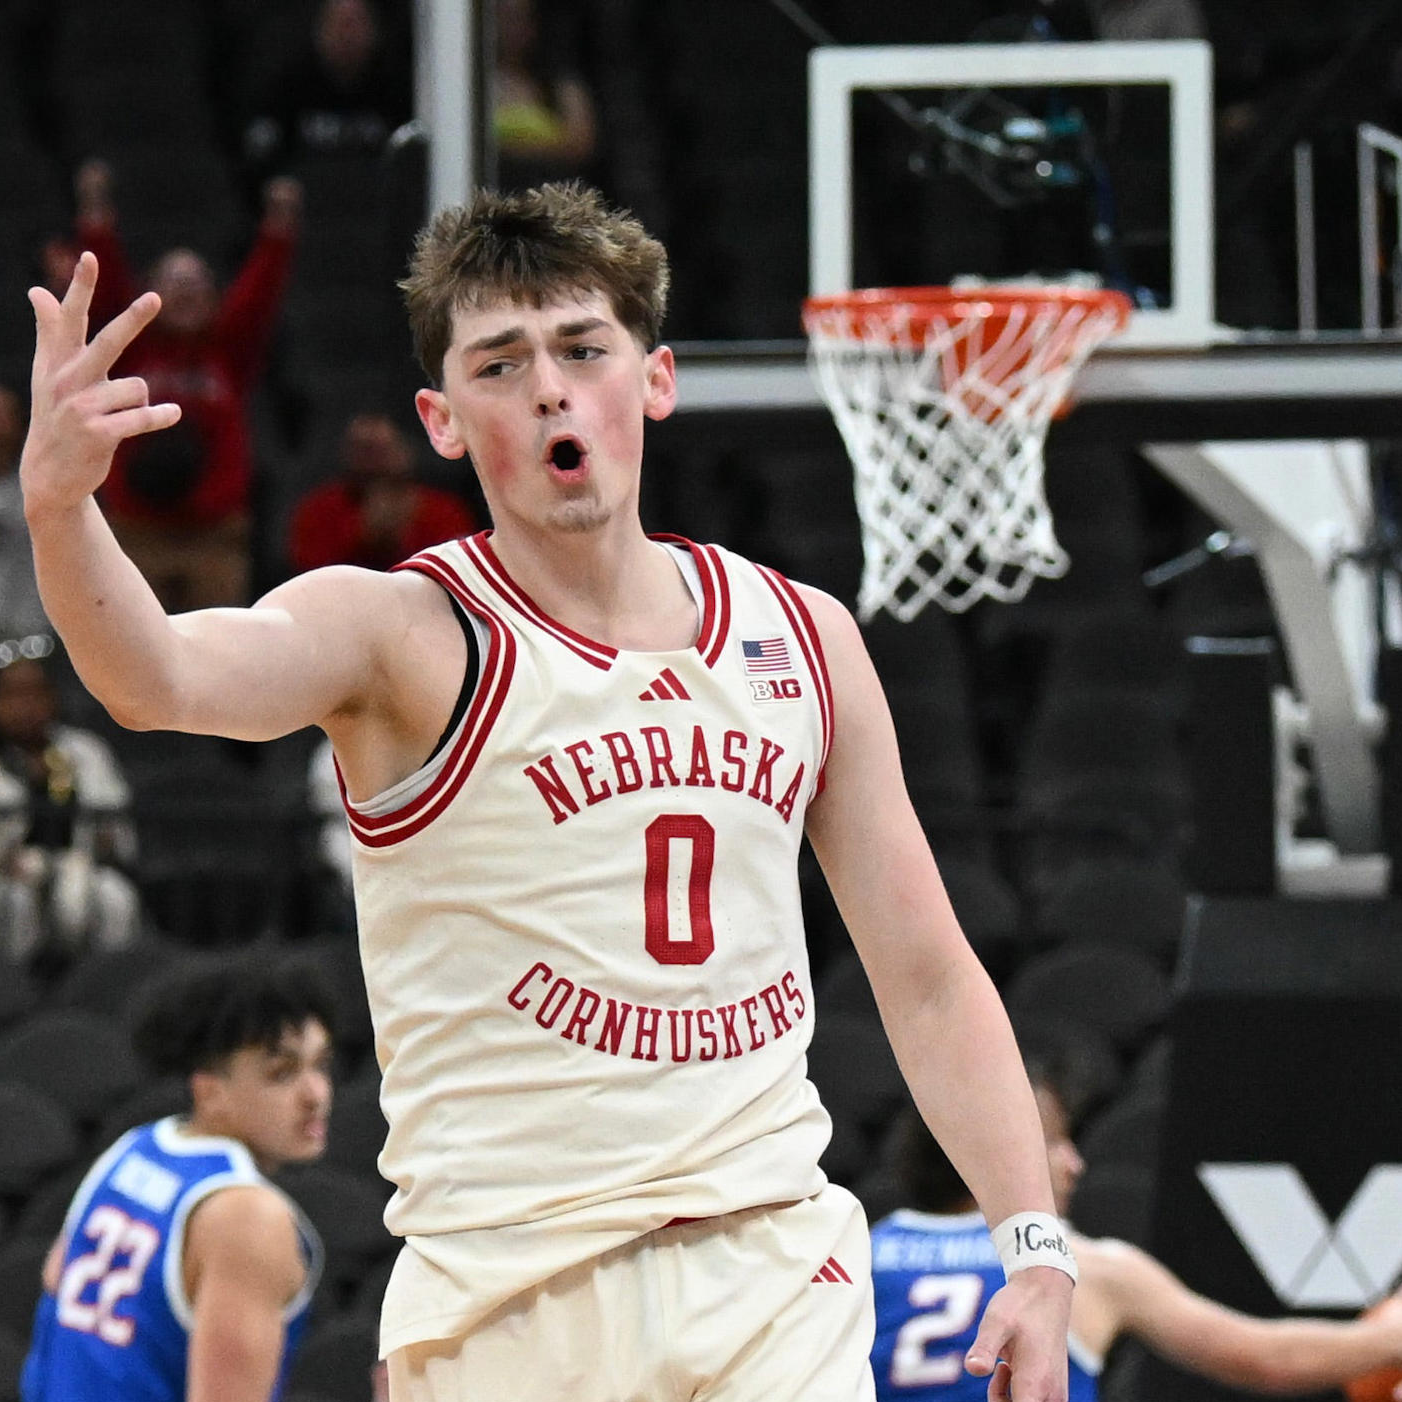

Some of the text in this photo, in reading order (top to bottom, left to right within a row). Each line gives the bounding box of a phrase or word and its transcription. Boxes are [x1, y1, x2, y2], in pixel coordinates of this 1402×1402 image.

[523, 724, 806, 825] NEBRASKA
[644, 814, 715, 965] 0
[507, 961, 807, 1063] CORNHUSKERS
[55, 1204, 161, 1348] 22
[889, 1272, 985, 1390] 2
